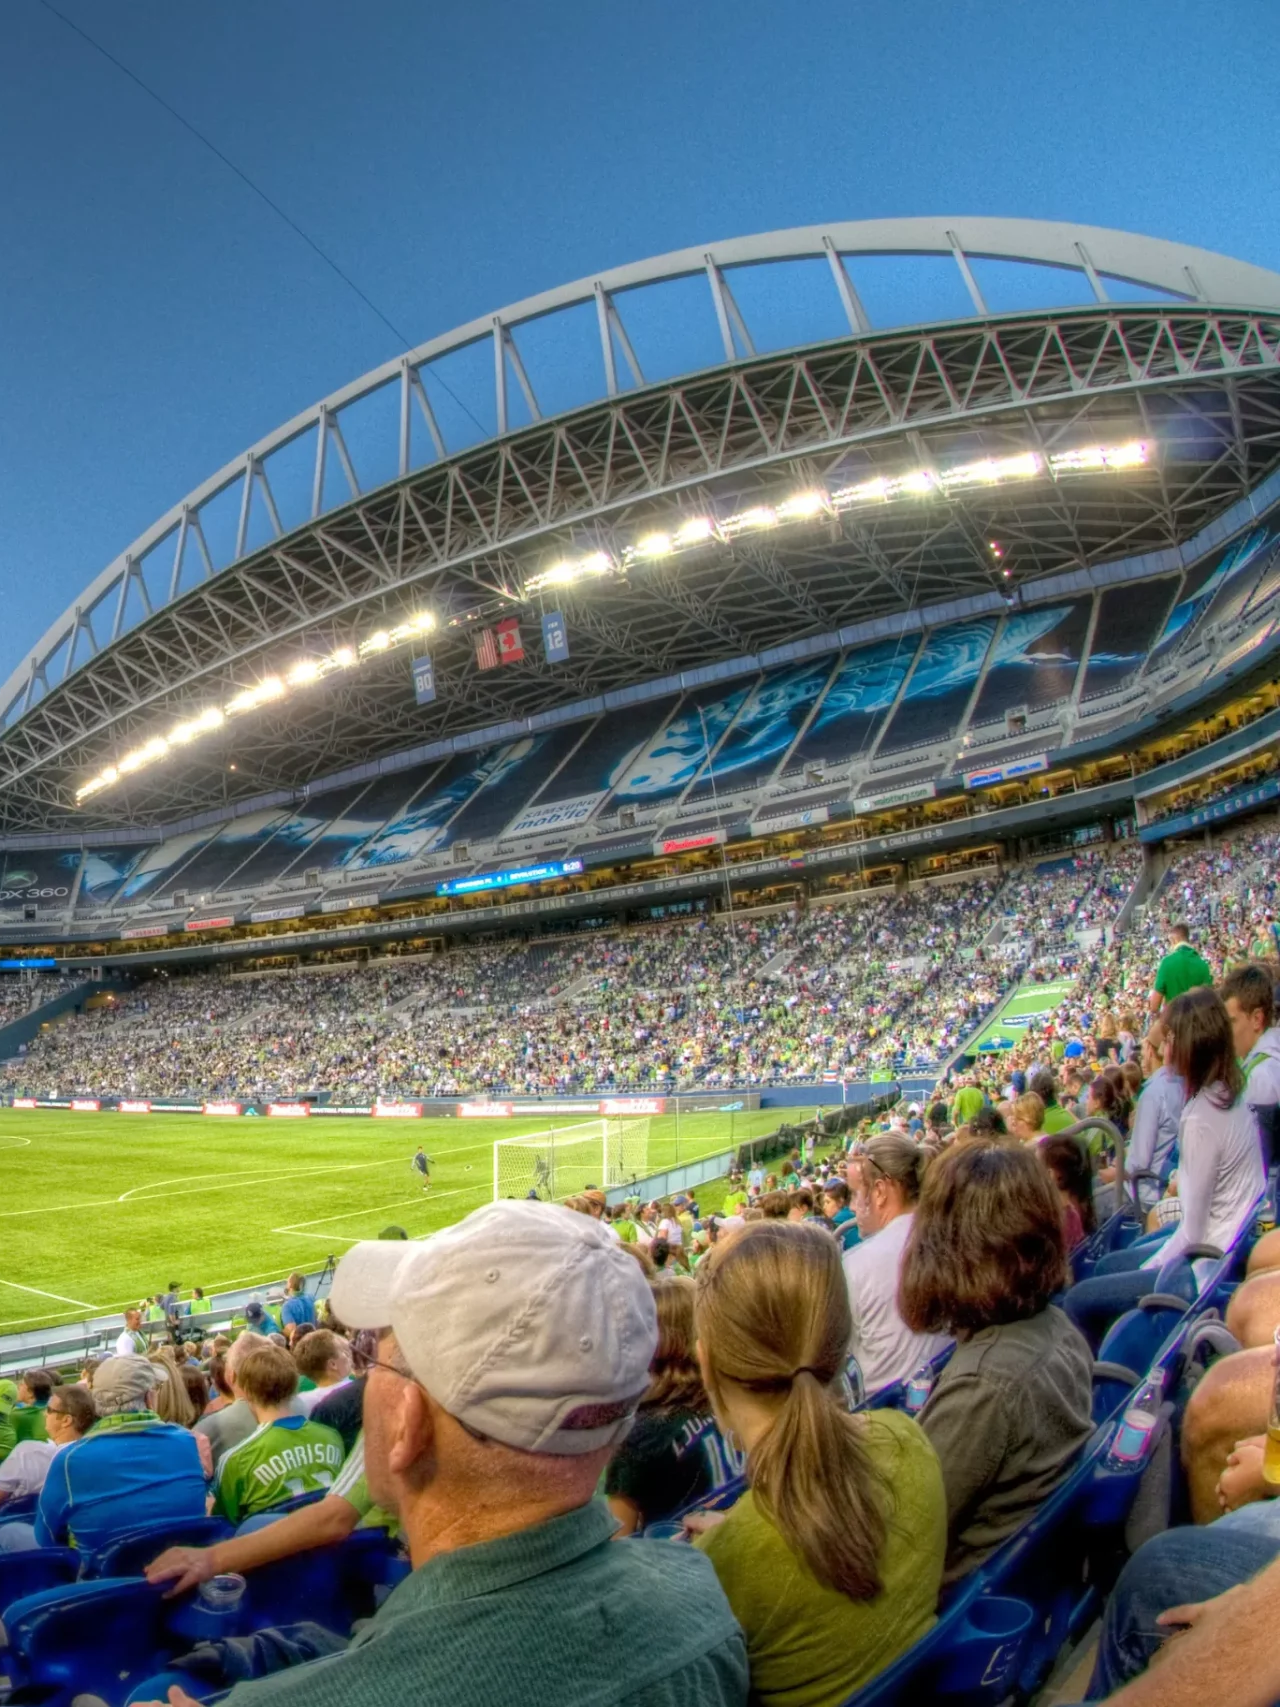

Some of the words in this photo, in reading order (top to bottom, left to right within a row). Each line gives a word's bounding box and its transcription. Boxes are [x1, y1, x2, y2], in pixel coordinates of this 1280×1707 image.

[546, 630, 564, 650] 12
[415, 673, 432, 693] 80
[523, 798, 597, 820] SAMSUNG
[26, 886, 69, 899] 360
[524, 902, 535, 912] OF
